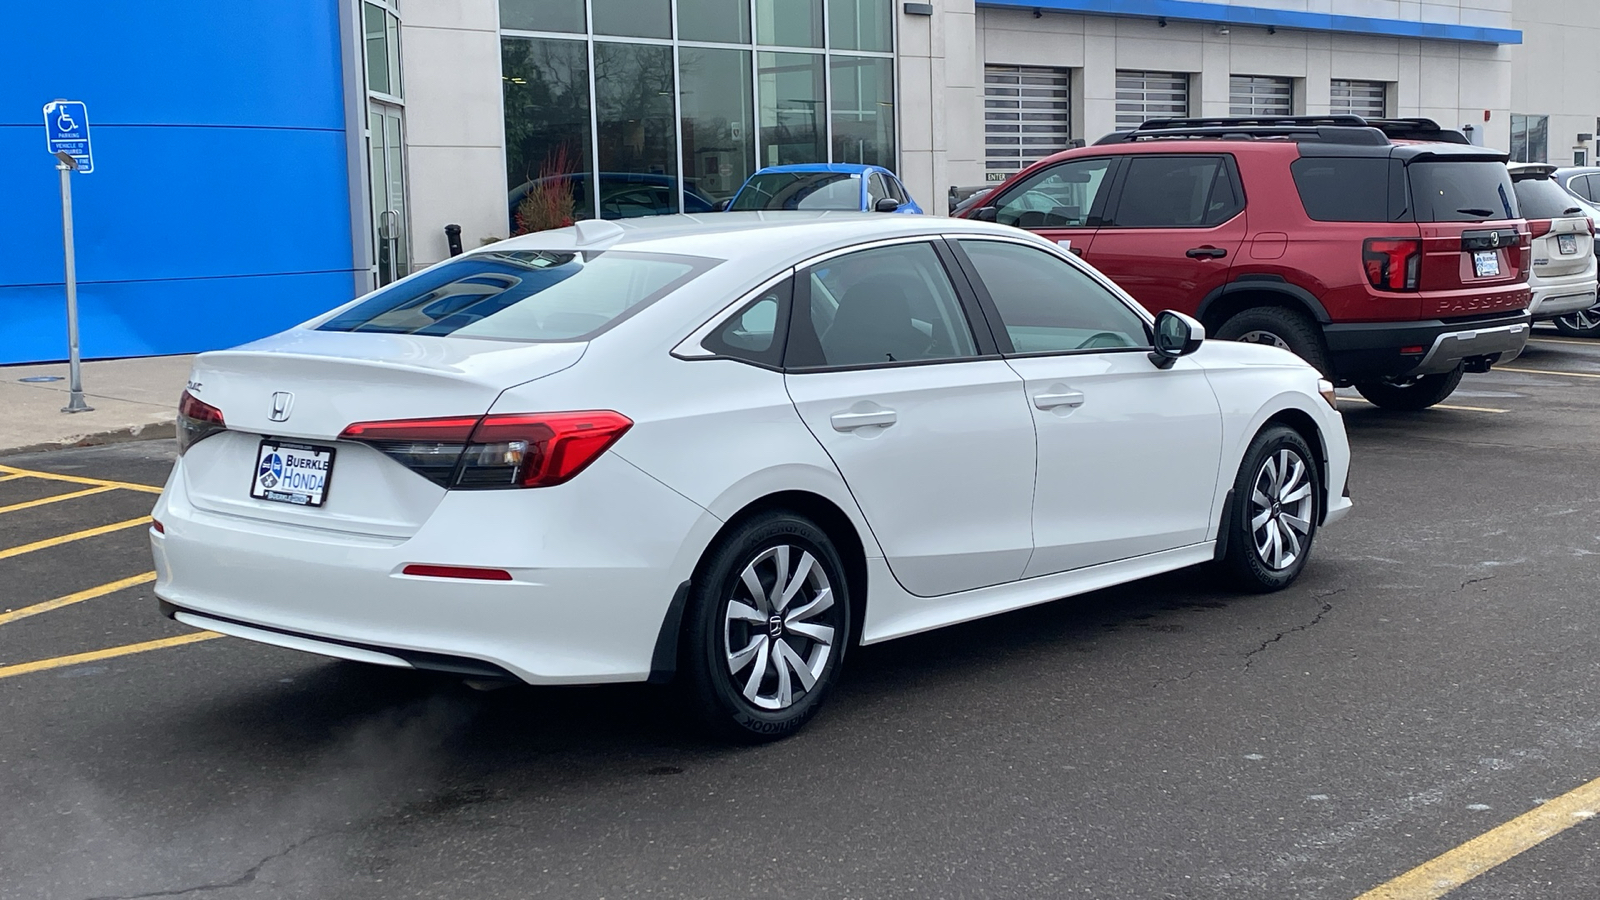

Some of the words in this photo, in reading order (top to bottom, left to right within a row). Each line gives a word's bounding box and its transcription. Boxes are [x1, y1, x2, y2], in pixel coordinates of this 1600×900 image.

[987, 173, 1006, 181] ENTER
[1436, 292, 1530, 312] PASSPORT
[286, 455, 329, 471] BUERKLE
[282, 468, 324, 491] HONDA
